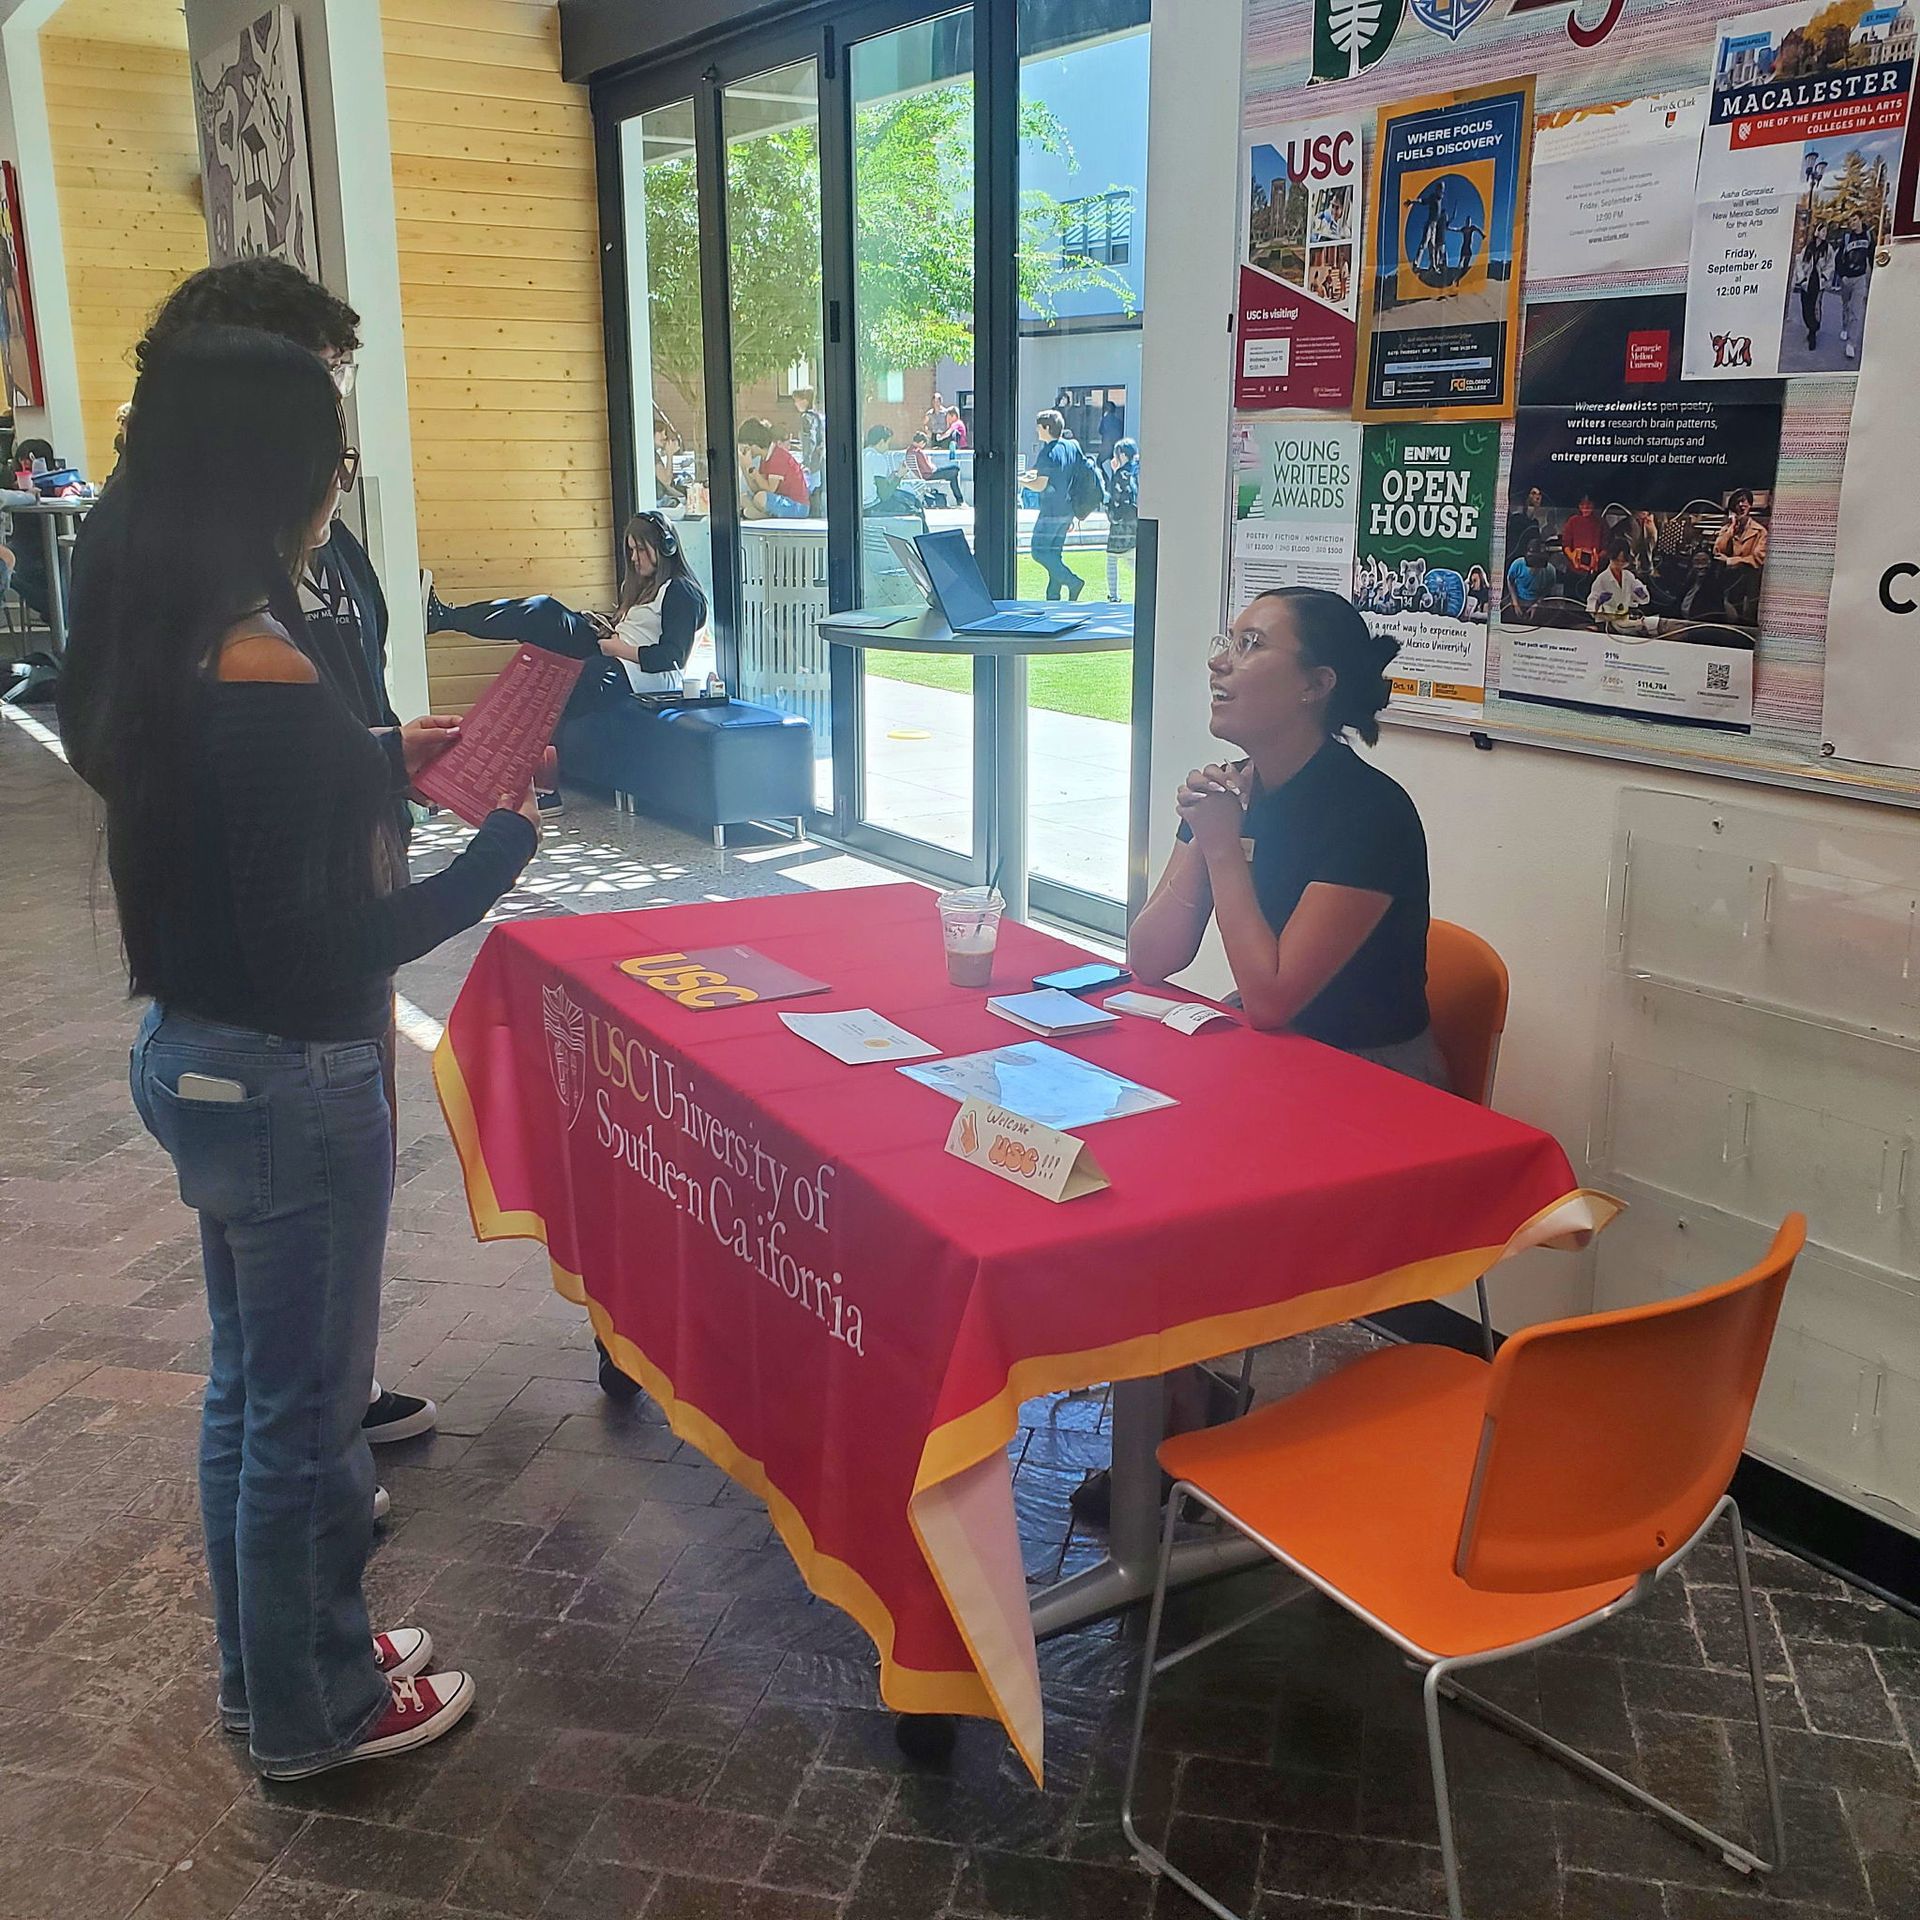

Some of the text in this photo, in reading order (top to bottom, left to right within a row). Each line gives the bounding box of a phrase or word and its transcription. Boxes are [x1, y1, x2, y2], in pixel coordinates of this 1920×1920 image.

[1721, 70, 1898, 117] MACALESTER
[1649, 97, 1696, 113] Lewis & Clark
[1757, 98, 1903, 129] ONE OF THE FEW LIBERAL ARTS
[1807, 113, 1901, 134] COLLEGES IN A CITY
[1407, 119, 1493, 145] WHERE FOCUS
[1396, 133, 1503, 162] FUELS DISCOVERY
[1286, 130, 1354, 183] USC
[1720, 186, 1774, 199] Aisha Gonzalez
[1733, 199, 1759, 207] will visit
[1712, 206, 1779, 221] New Mexico School
[1726, 218, 1763, 229] for the Arts
[1725, 248, 1757, 260] Friday,
[1707, 259, 1773, 275] September 26
[1716, 284, 1759, 297] 12:00 PM
[1246, 307, 1299, 320] USC is visiting!
[1630, 351, 1653, 361] Mellon
[1631, 343, 1662, 353] Carnegie
[1629, 359, 1663, 369] University
[1574, 400, 1714, 413] Where scientists pen poetry,
[1567, 417, 1719, 431] writers research brain patterns,
[1576, 434, 1705, 448] artists launch startups and
[1274, 440, 1340, 462] YOUNG
[1403, 446, 1451, 461] ENMU
[1551, 451, 1728, 466] entrepreneurs sculpt a better world.
[1273, 464, 1350, 485] WRITERS
[1382, 470, 1471, 503] OPEN
[1271, 487, 1344, 509] AWARDS
[1370, 503, 1479, 539] HOUSE
[1246, 532, 1344, 543] POETRY FICTION NONFICTION
[1367, 619, 1374, 630] is
[1382, 619, 1400, 634] great
[1403, 624, 1417, 637] way
[1420, 622, 1428, 633] to
[1429, 626, 1467, 641] experience
[1406, 638, 1471, 658] Mexico University!
[1527, 641, 1539, 650] path
[1393, 682, 1405, 690] Oct.
[619, 952, 759, 1008] USC
[589, 1012, 835, 1233] USC Universty of
[986, 1108, 1030, 1136] Welcome
[709, 1175, 865, 1358] Caifornia
